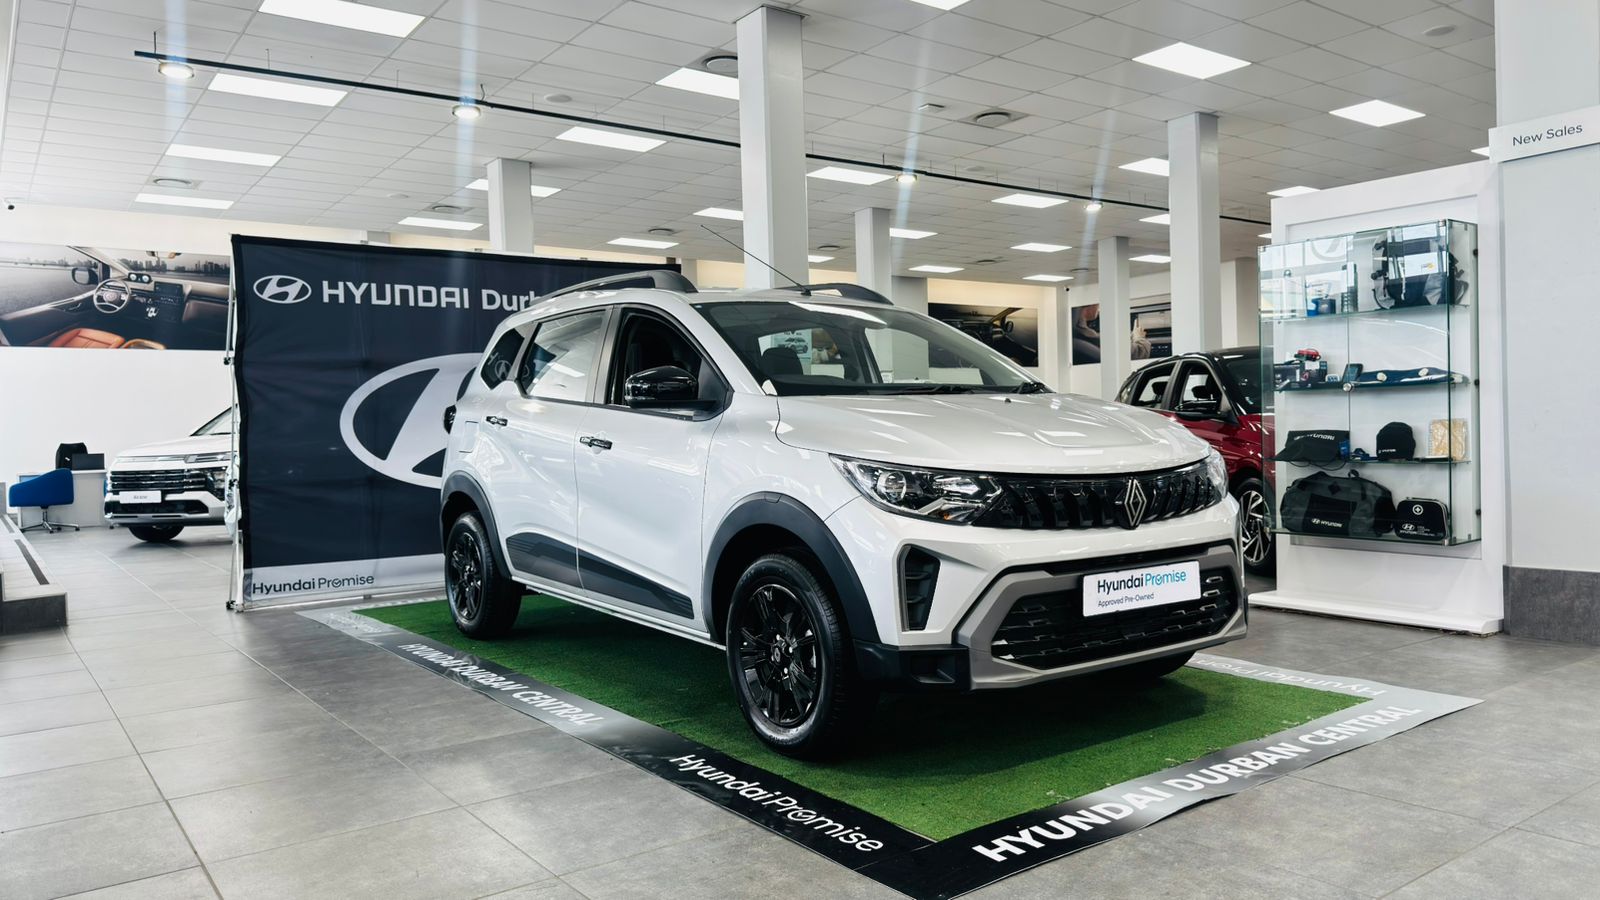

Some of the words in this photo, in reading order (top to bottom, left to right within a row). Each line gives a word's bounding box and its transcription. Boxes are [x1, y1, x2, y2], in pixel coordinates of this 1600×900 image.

[1512, 133, 1543, 147] New
[1546, 124, 1583, 140] Sales
[322, 280, 470, 309] HYUNDAI
[252, 578, 316, 595] Hyundai
[317, 574, 375, 589] Promise
[1097, 573, 1144, 596] Hyundai
[1144, 570, 1187, 587] Promise
[1098, 596, 1124, 608] Approved
[1124, 593, 1155, 604] Pre-Owned
[397, 643, 469, 669] HYUNDAI
[448, 664, 529, 691] DURBAN
[511, 690, 605, 726] CENTRAL
[971, 786, 1175, 863] HYUNDAI
[1162, 742, 1313, 792] DURBAN
[1298, 706, 1423, 746] CENTRAL
[669, 754, 782, 806] Hyundai
[775, 795, 884, 852] Promise
